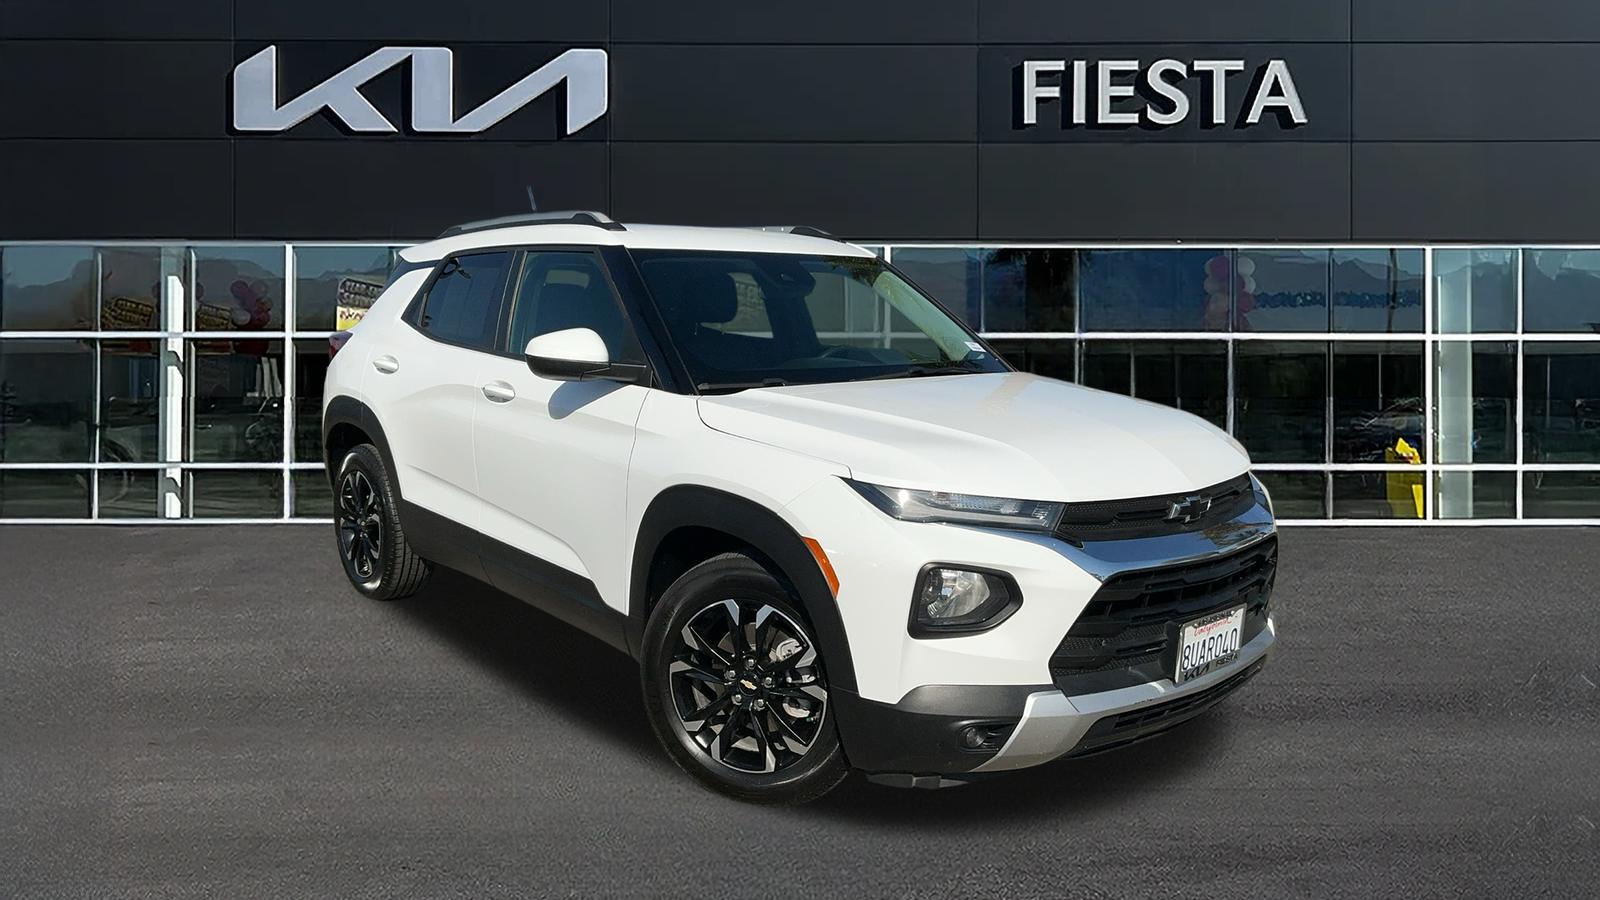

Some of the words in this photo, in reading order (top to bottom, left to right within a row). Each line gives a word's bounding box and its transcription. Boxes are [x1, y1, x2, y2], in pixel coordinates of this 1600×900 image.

[233, 45, 609, 133] KIA
[1022, 59, 1307, 126] FIESTA
[1182, 628, 1238, 670] 8UAR040
